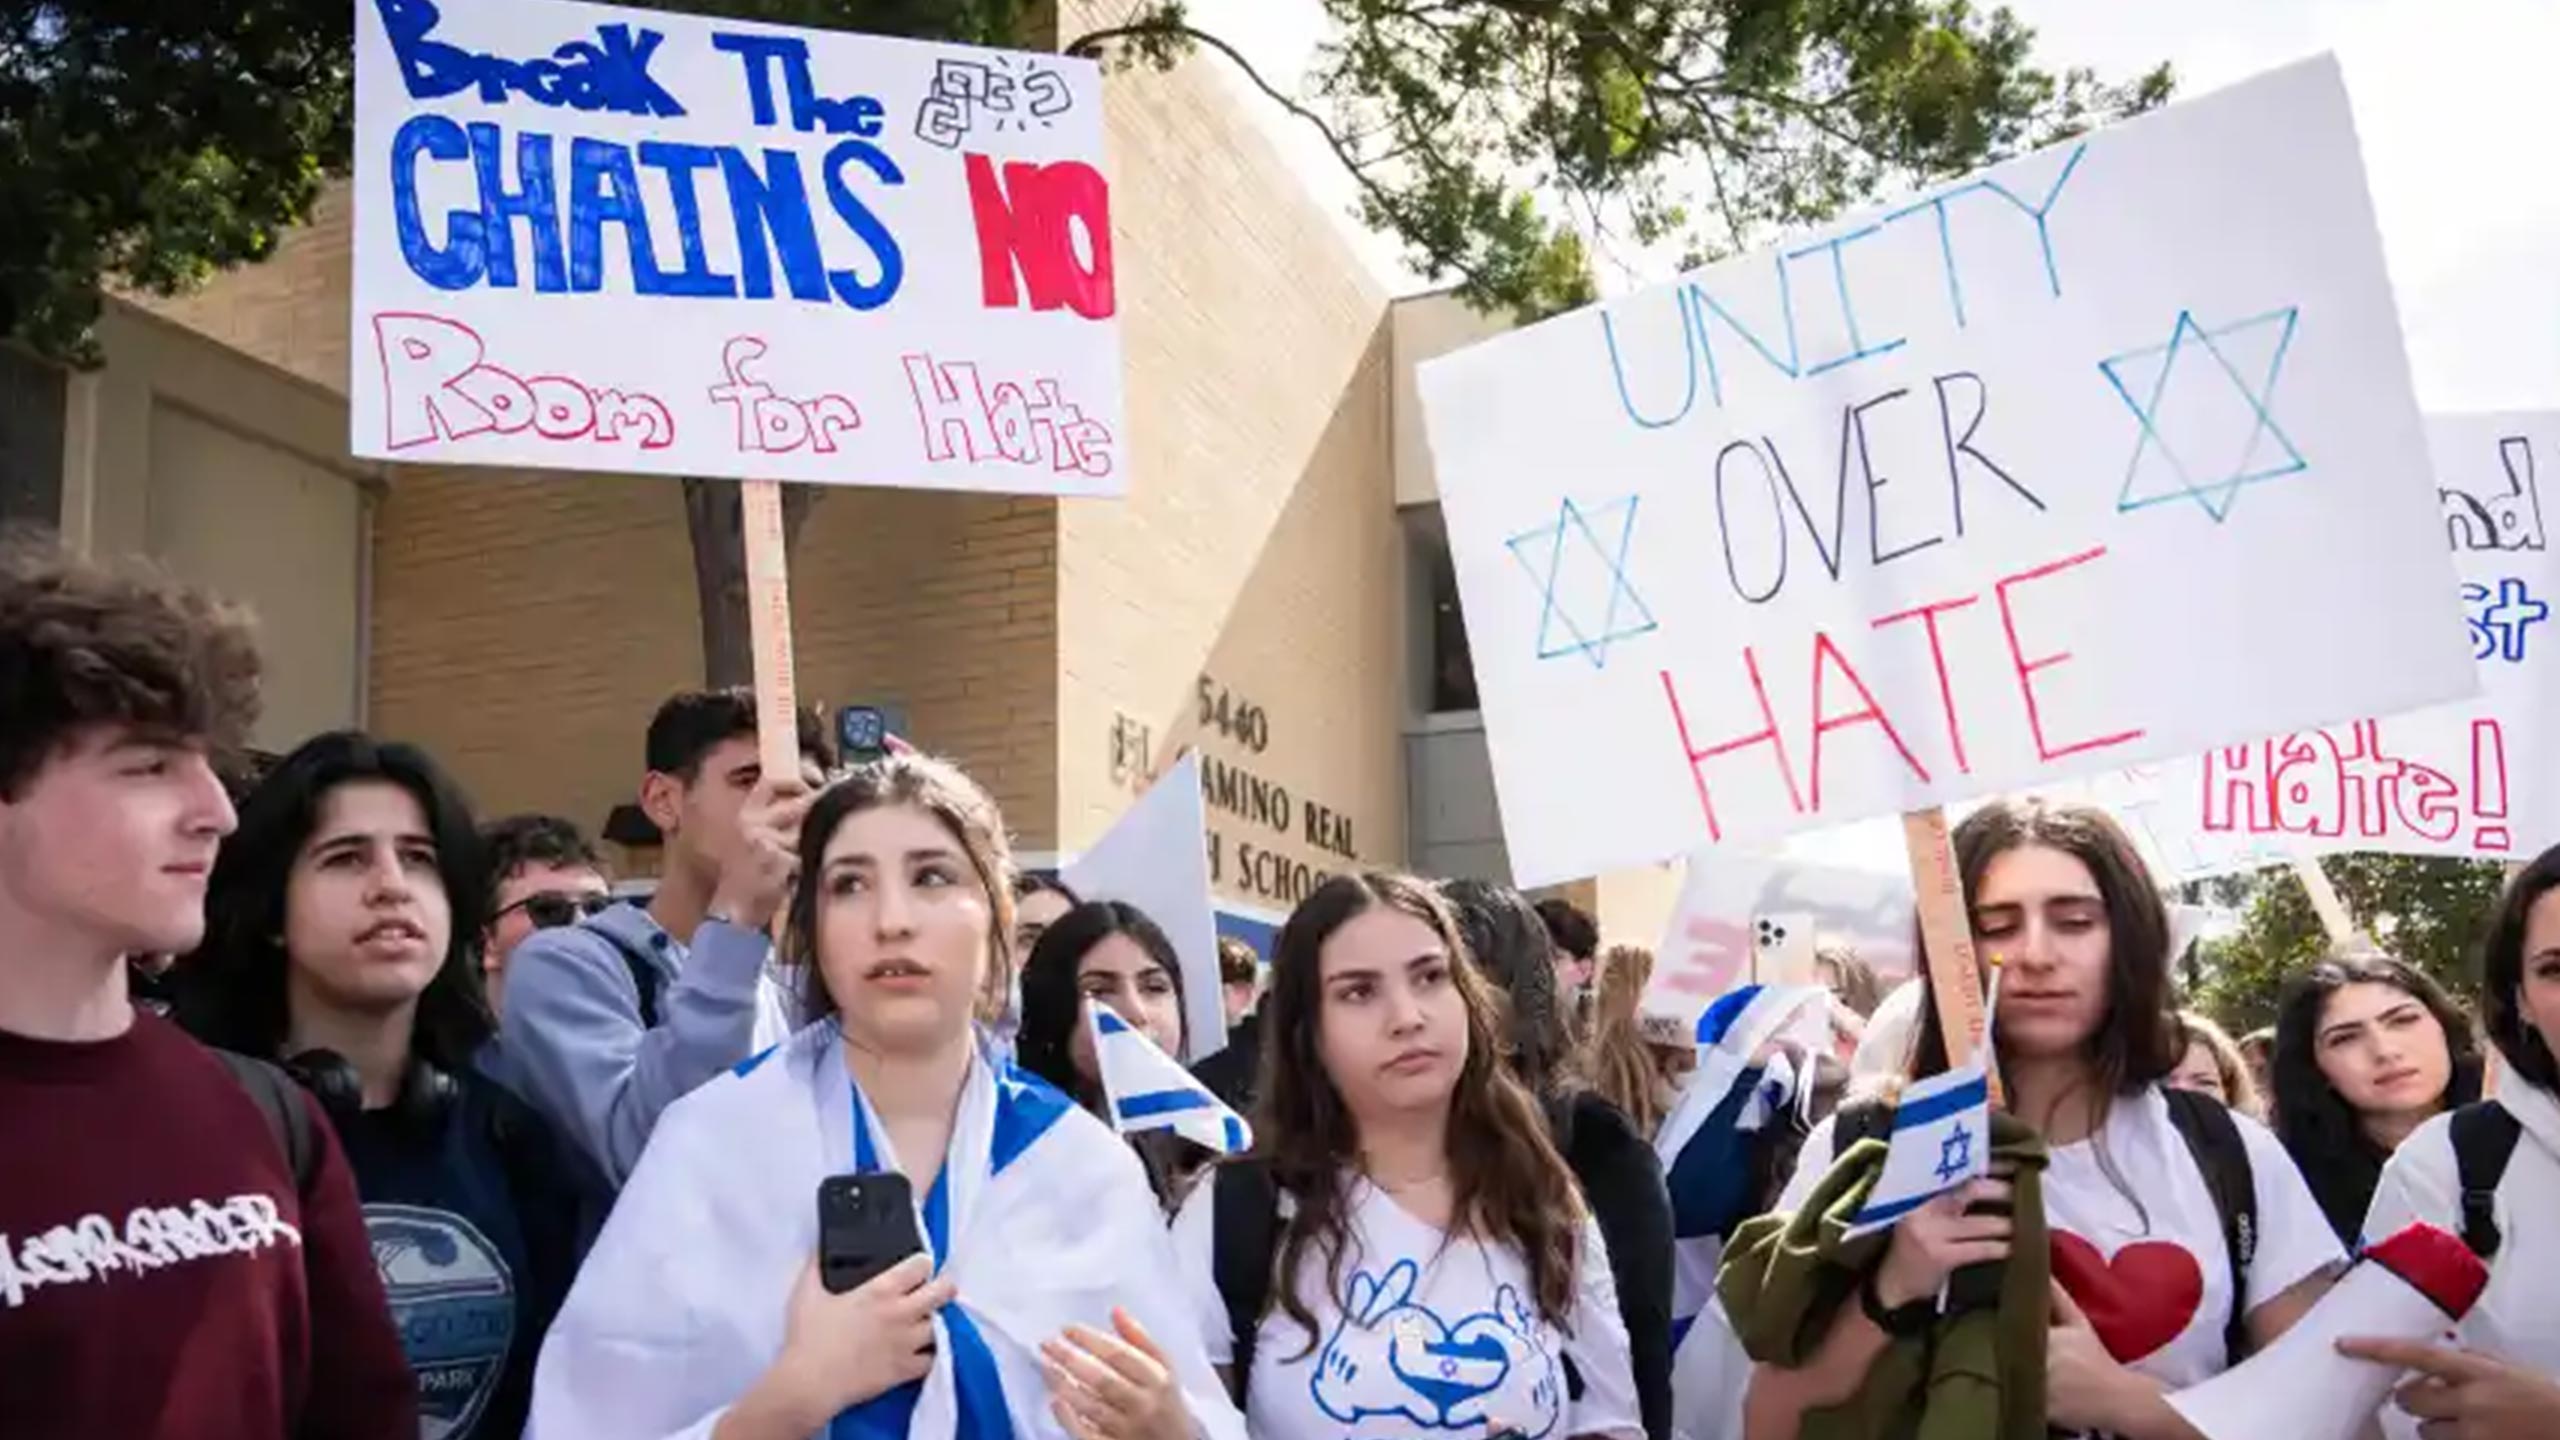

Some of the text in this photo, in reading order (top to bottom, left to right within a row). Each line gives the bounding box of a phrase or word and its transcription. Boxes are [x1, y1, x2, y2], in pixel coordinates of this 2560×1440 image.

[711, 32, 884, 138] The
[391, 114, 1115, 320] CHAINS NO
[1600, 143, 2088, 430] UNITY
[373, 311, 1112, 476] Room for Hate
[1715, 372, 2046, 604] OVER
[1199, 672, 1267, 752] 5440
[1660, 546, 2145, 843] HATE
[1178, 745, 1290, 833] AMINO
[1305, 801, 1356, 859] REAL
[2202, 718, 2511, 851] Hate!
[1238, 842, 1328, 902] SCHO
